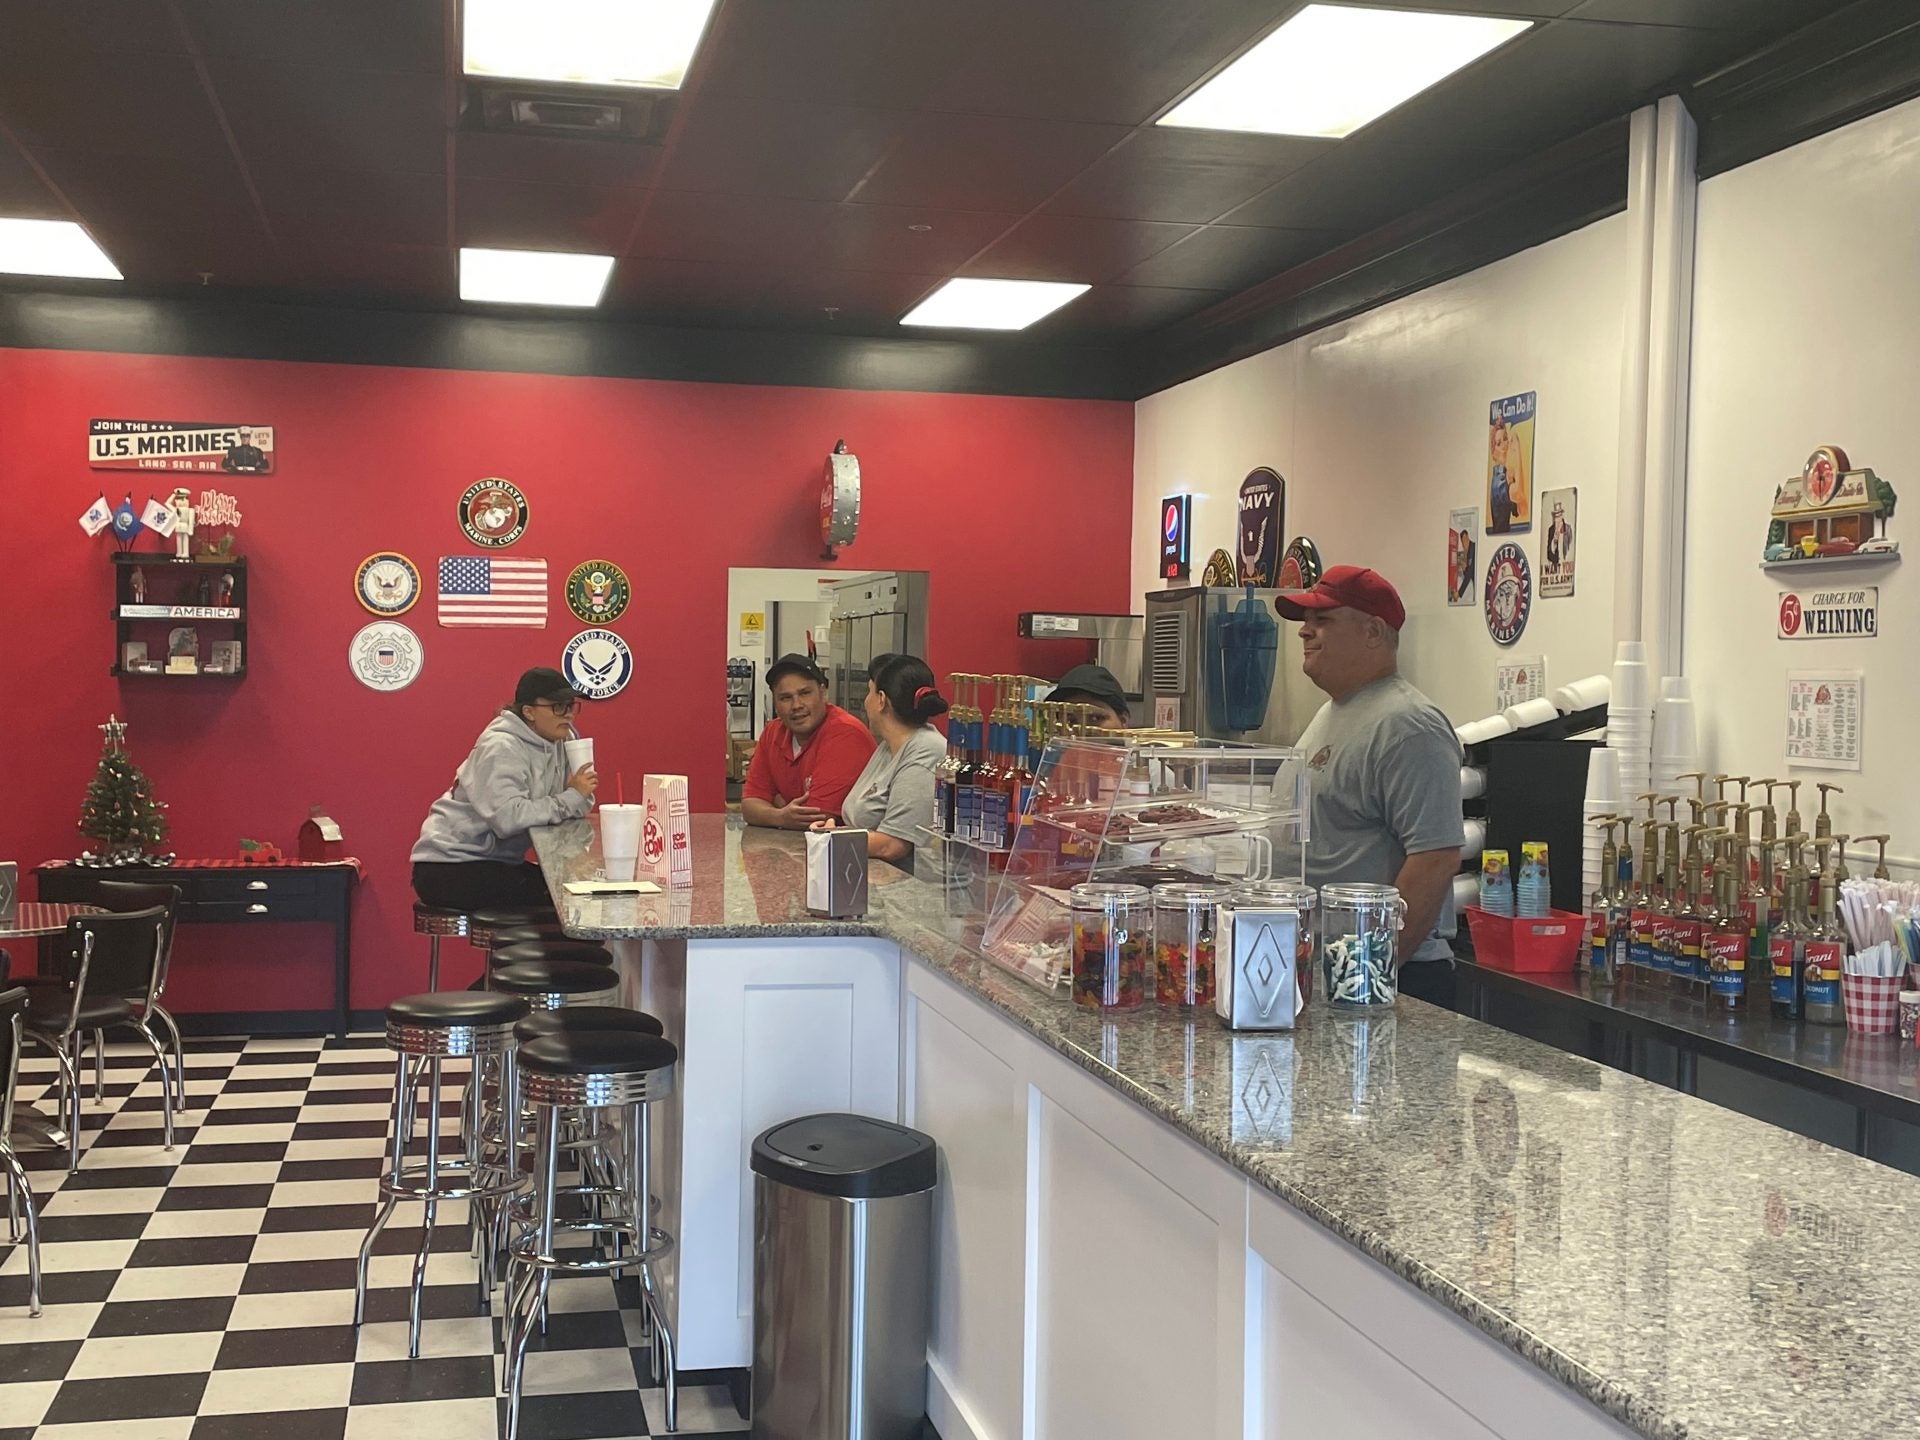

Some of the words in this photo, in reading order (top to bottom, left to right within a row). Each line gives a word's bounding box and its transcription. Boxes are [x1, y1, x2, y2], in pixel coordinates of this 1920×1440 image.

[1503, 400, 1516, 417] Can
[1517, 397, 1526, 415] Do
[94, 421, 122, 431] JOIN
[125, 423, 148, 431] THE
[96, 437, 133, 456] U.S.
[138, 432, 236, 455] MARINES
[139, 459, 167, 468] LAND
[172, 461, 193, 470] SEA
[199, 462, 217, 470] AIR
[463, 480, 493, 505] UNITED
[498, 481, 525, 508] STATES
[1239, 492, 1275, 512] NAVY
[464, 522, 493, 545] MARINE
[498, 526, 523, 545] CORPS
[570, 562, 598, 584] UNITED
[600, 562, 625, 585] STATES
[1562, 561, 1575, 574] YOU
[1486, 547, 1516, 585] UNITED
[1518, 558, 1529, 621] STATES
[1813, 593, 1847, 606] CHARGE
[1847, 591, 1866, 604] FOR
[174, 607, 236, 618] AMERICA
[583, 612, 614, 622] ARMY
[1486, 600, 1516, 640] MARINES
[1803, 608, 1875, 634] WHINING
[567, 632, 597, 655] UNITED
[599, 632, 627, 655] STATES
[573, 679, 591, 696] AIR
[592, 681, 621, 698] FORCE
[644, 820, 657, 841] POP
[644, 836, 663, 858] CORN
[1724, 975, 1742, 984] BEAN
